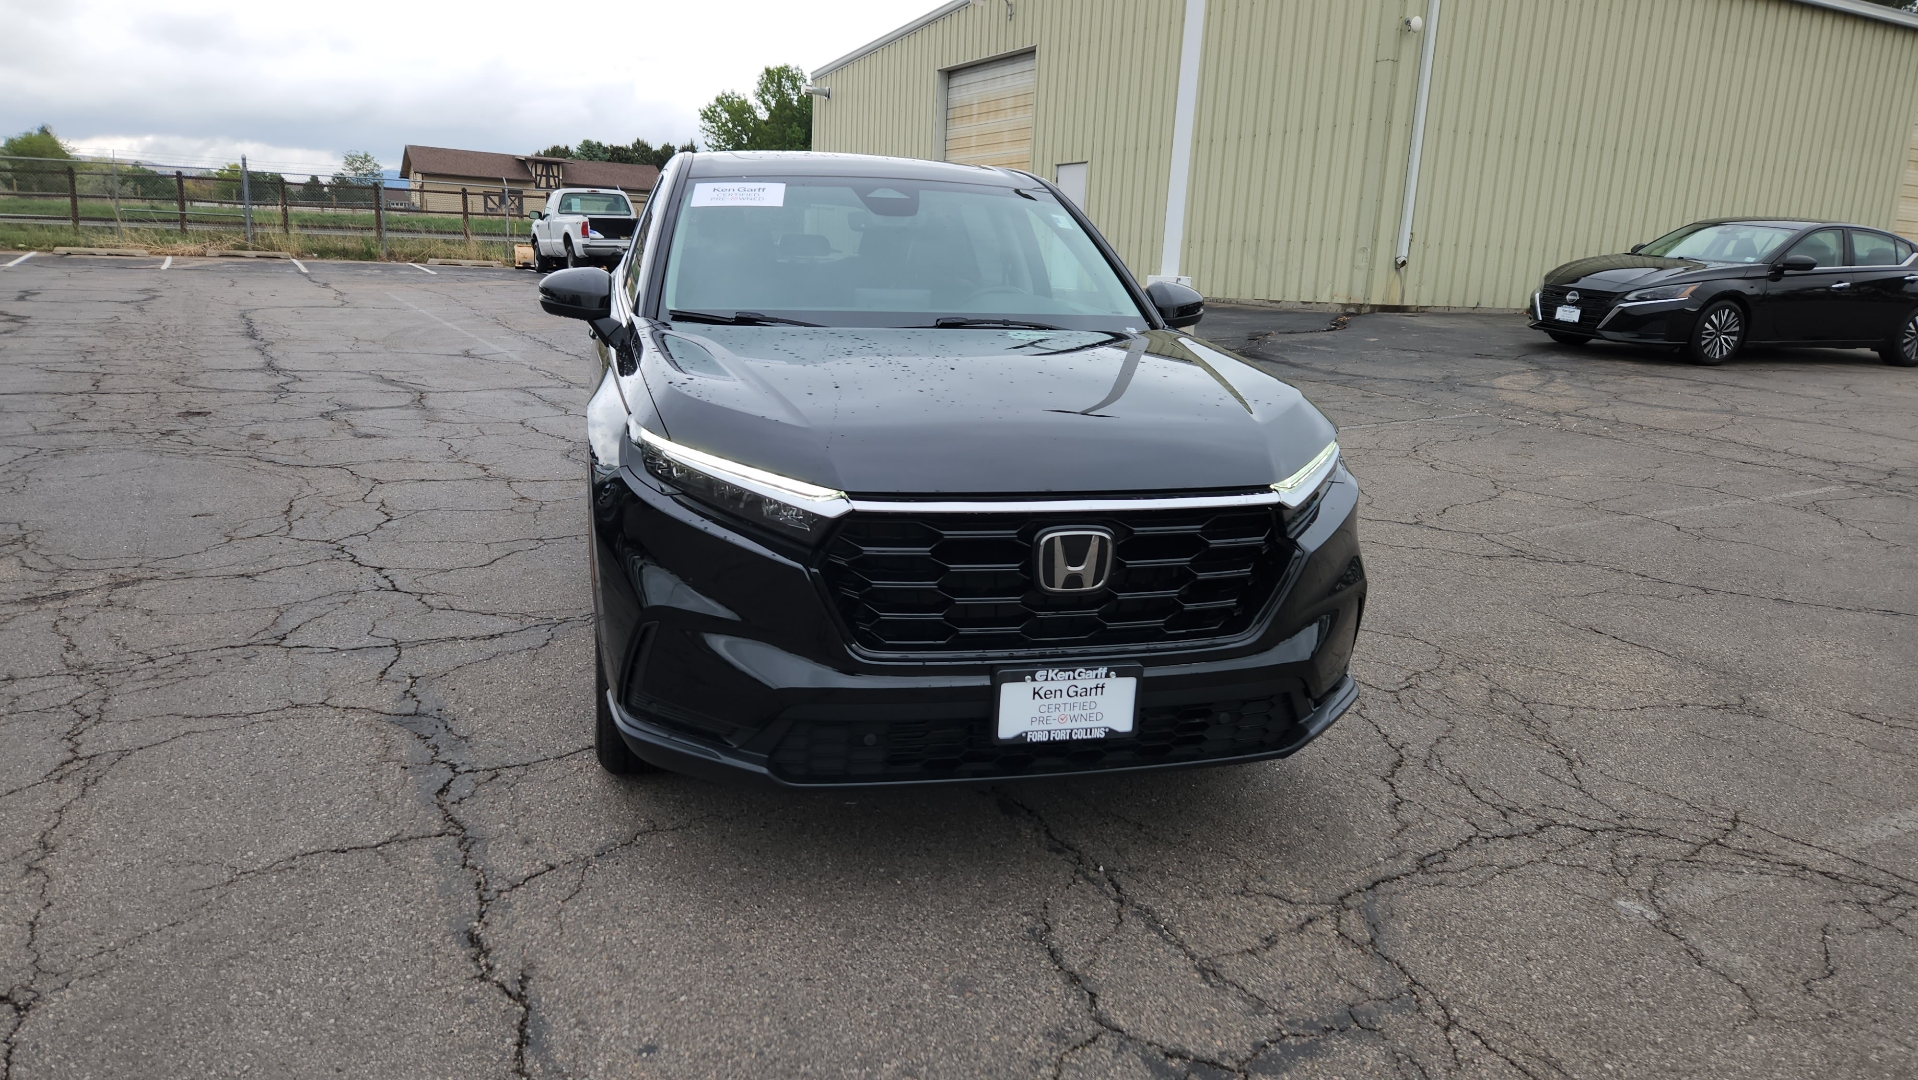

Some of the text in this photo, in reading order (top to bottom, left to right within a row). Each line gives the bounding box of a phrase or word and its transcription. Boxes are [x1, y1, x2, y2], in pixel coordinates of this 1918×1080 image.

[1032, 683, 1106, 700] Ken Garff
[1038, 701, 1097, 714] CERTIFIED
[1026, 727, 1106, 742] FORD FORT COLLINS
